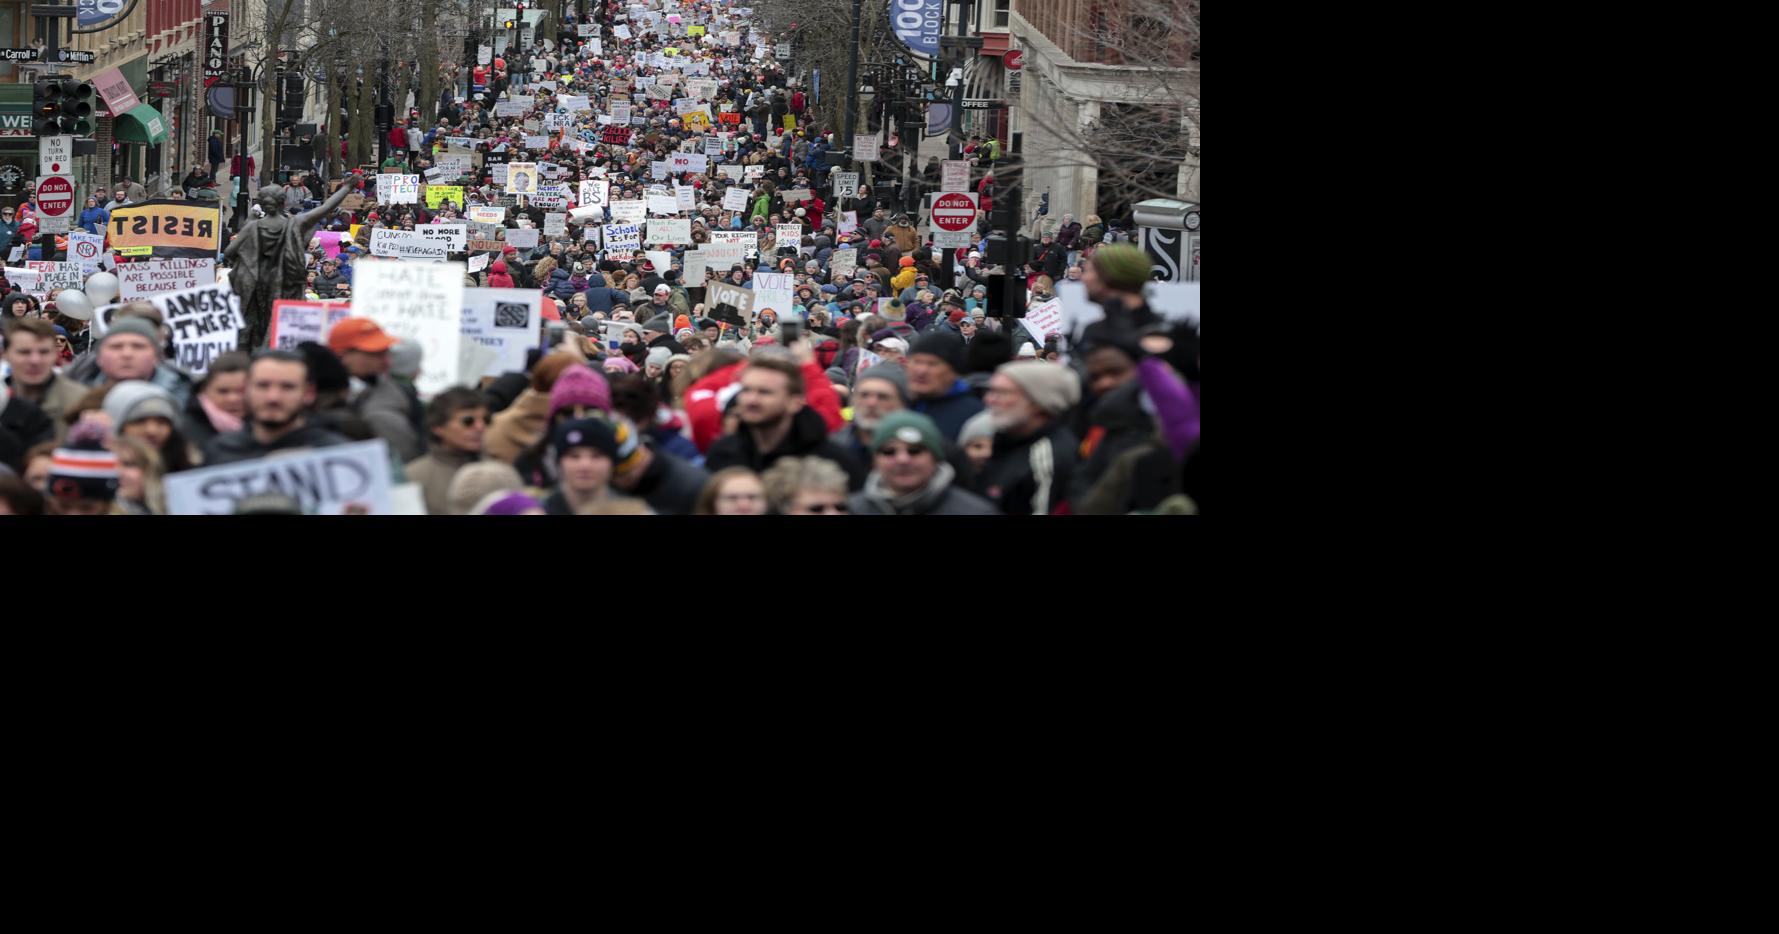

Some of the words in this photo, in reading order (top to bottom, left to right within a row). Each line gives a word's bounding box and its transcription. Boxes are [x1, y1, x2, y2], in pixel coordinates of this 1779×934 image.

[922, 1, 940, 44] BLOCK
[210, 15, 225, 69] PIANO
[5, 49, 31, 59] Carroll
[50, 139, 61, 147] NO
[48, 147, 64, 155] TURN
[44, 155, 53, 163] ON
[55, 154, 67, 162] RED
[840, 186, 853, 196] 15
[43, 202, 67, 210] ENTER
[939, 217, 969, 225] ENTER
[59, 262, 80, 271] HAS
[119, 263, 150, 273] MASS
[160, 258, 208, 271] KILLINGS
[44, 273, 67, 282] PLACE
[69, 272, 79, 281] IN
[124, 273, 144, 283] ARE
[150, 269, 195, 281] POSSIBLE
[135, 280, 178, 293] BECAUSE
[185, 279, 197, 289] OF
[710, 285, 749, 310] VOTE
[165, 288, 233, 319] ANGRY
[198, 455, 371, 502] STAND
